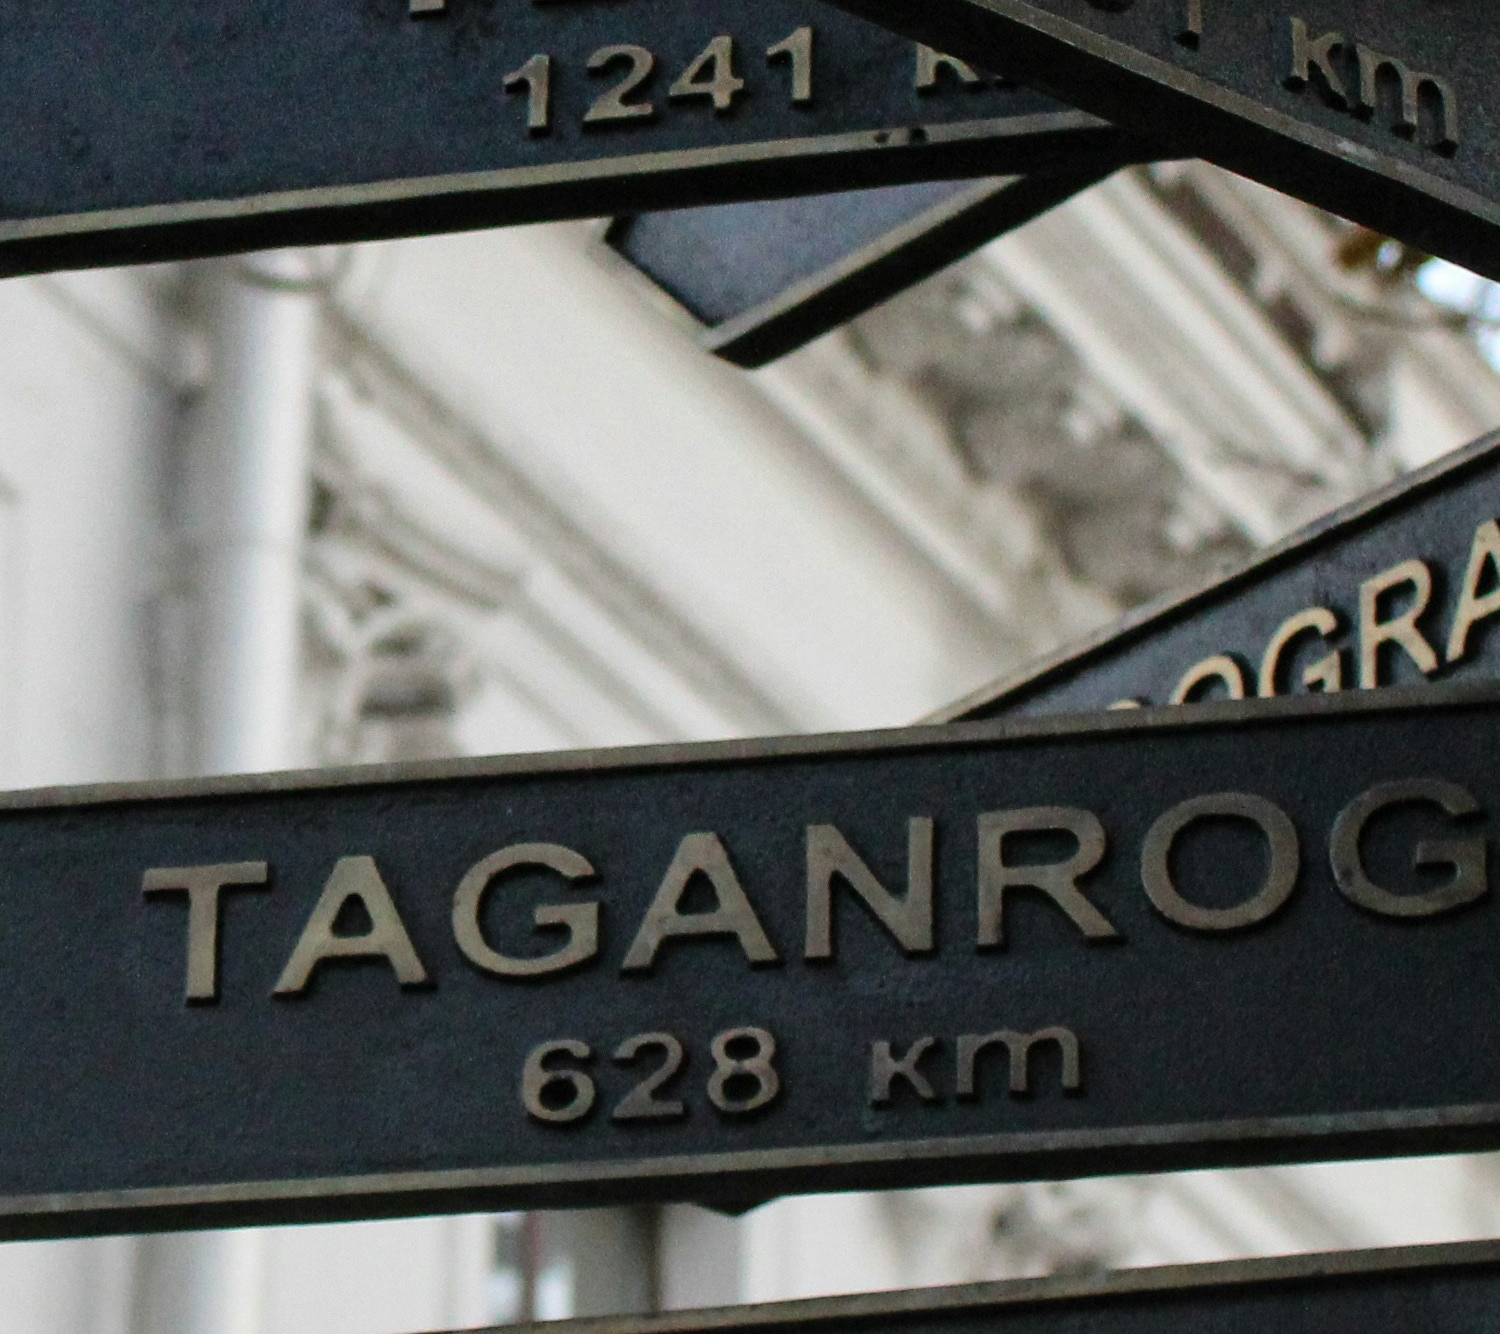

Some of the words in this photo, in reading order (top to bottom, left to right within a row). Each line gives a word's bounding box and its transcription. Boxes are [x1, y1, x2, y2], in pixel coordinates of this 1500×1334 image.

[503, 25, 814, 129] 1241
[1290, 17, 1459, 147] km
[143, 779, 1488, 1000] TAGANROG
[520, 1025, 781, 1122] 628
[870, 1026, 1082, 1101] km
